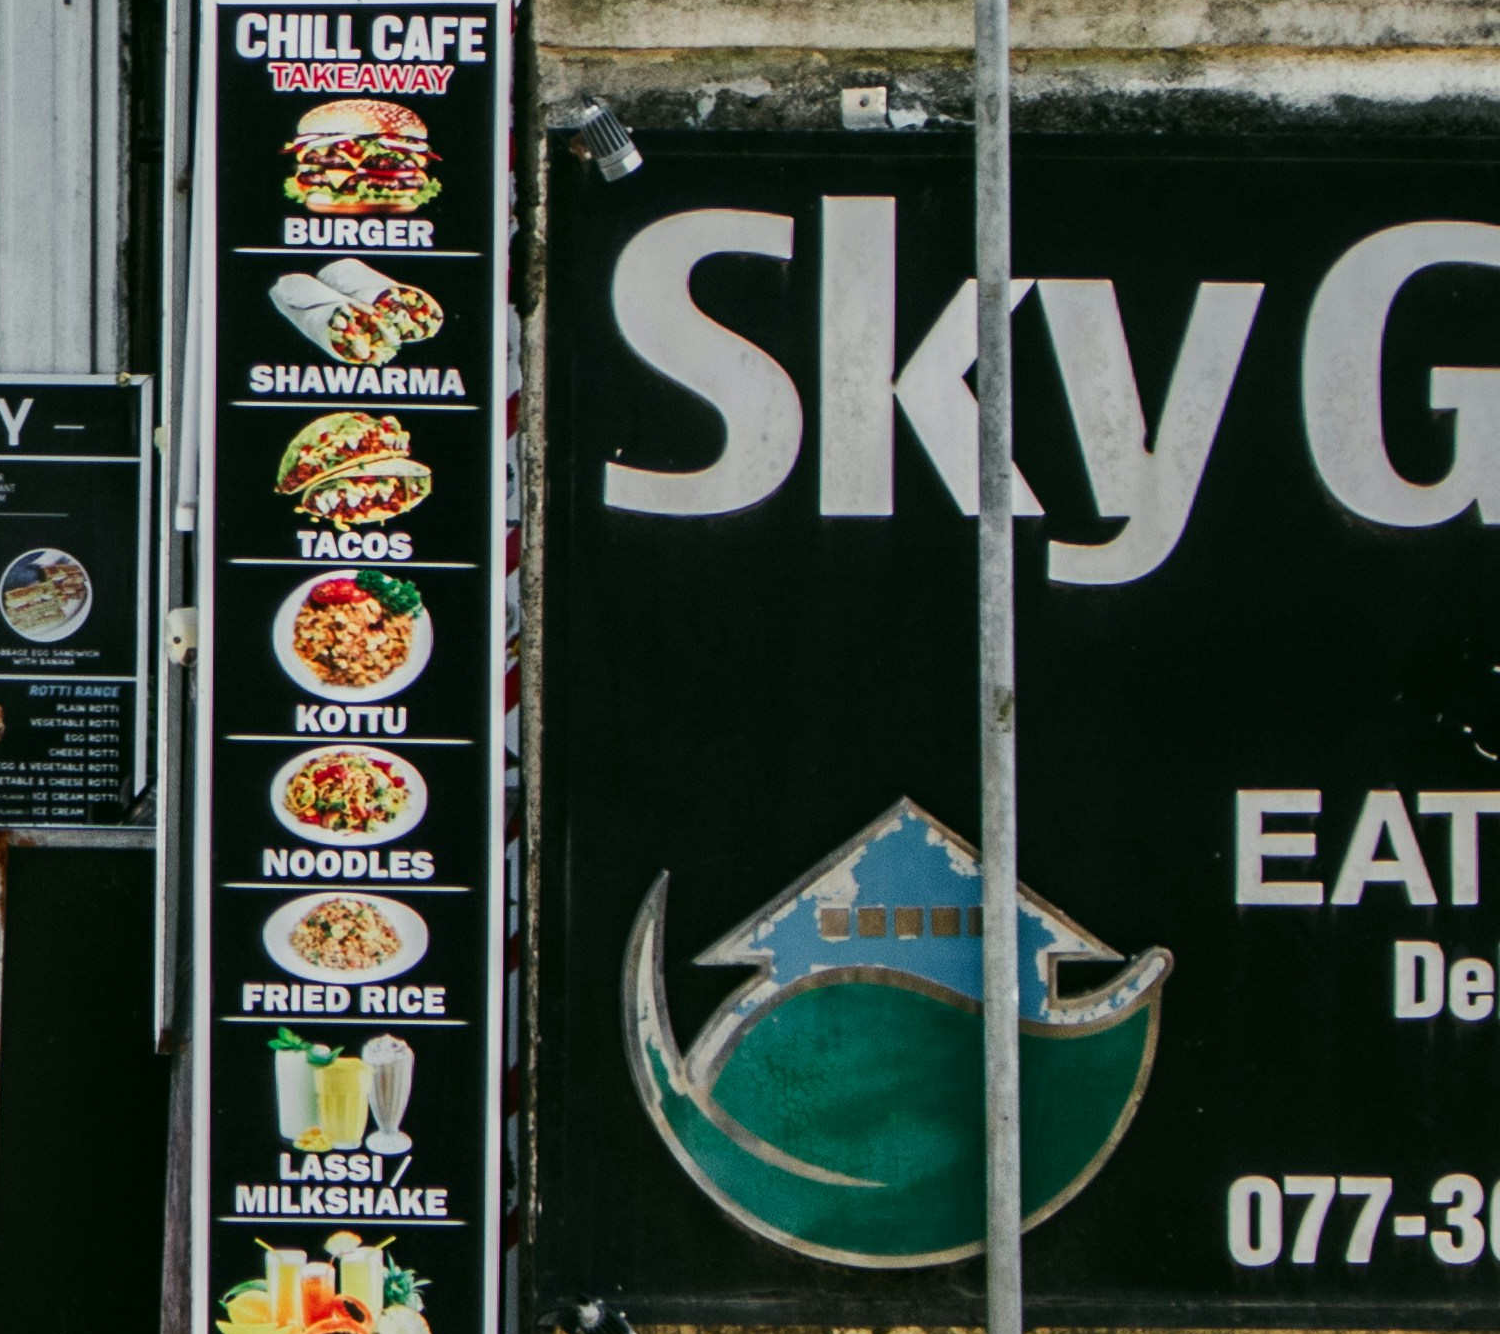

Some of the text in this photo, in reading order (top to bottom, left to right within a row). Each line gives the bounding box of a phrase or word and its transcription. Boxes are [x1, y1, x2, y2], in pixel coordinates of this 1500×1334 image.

[235, 12, 487, 63] CHILL CAFE
[267, 62, 455, 95] TAKEAWAY
[283, 217, 434, 248] BURGER
[249, 365, 466, 397] SHAWARMA
[603, 195, 1266, 586] Sky
[296, 530, 414, 561] TACOS
[29, 685, 121, 698] ROTTI RANGE
[30, 718, 120, 728] VEGETABLE ROTTI
[295, 704, 408, 735] KOTTU
[262, 848, 436, 880] NOODLES
[1394, 939, 1500, 1022] De
[242, 983, 447, 1015] FRIED RICE
[279, 1153, 413, 1188] LASSI /
[233, 1184, 449, 1218] MILKSHAKE
[1227, 1172, 1500, 1267] 077-3
